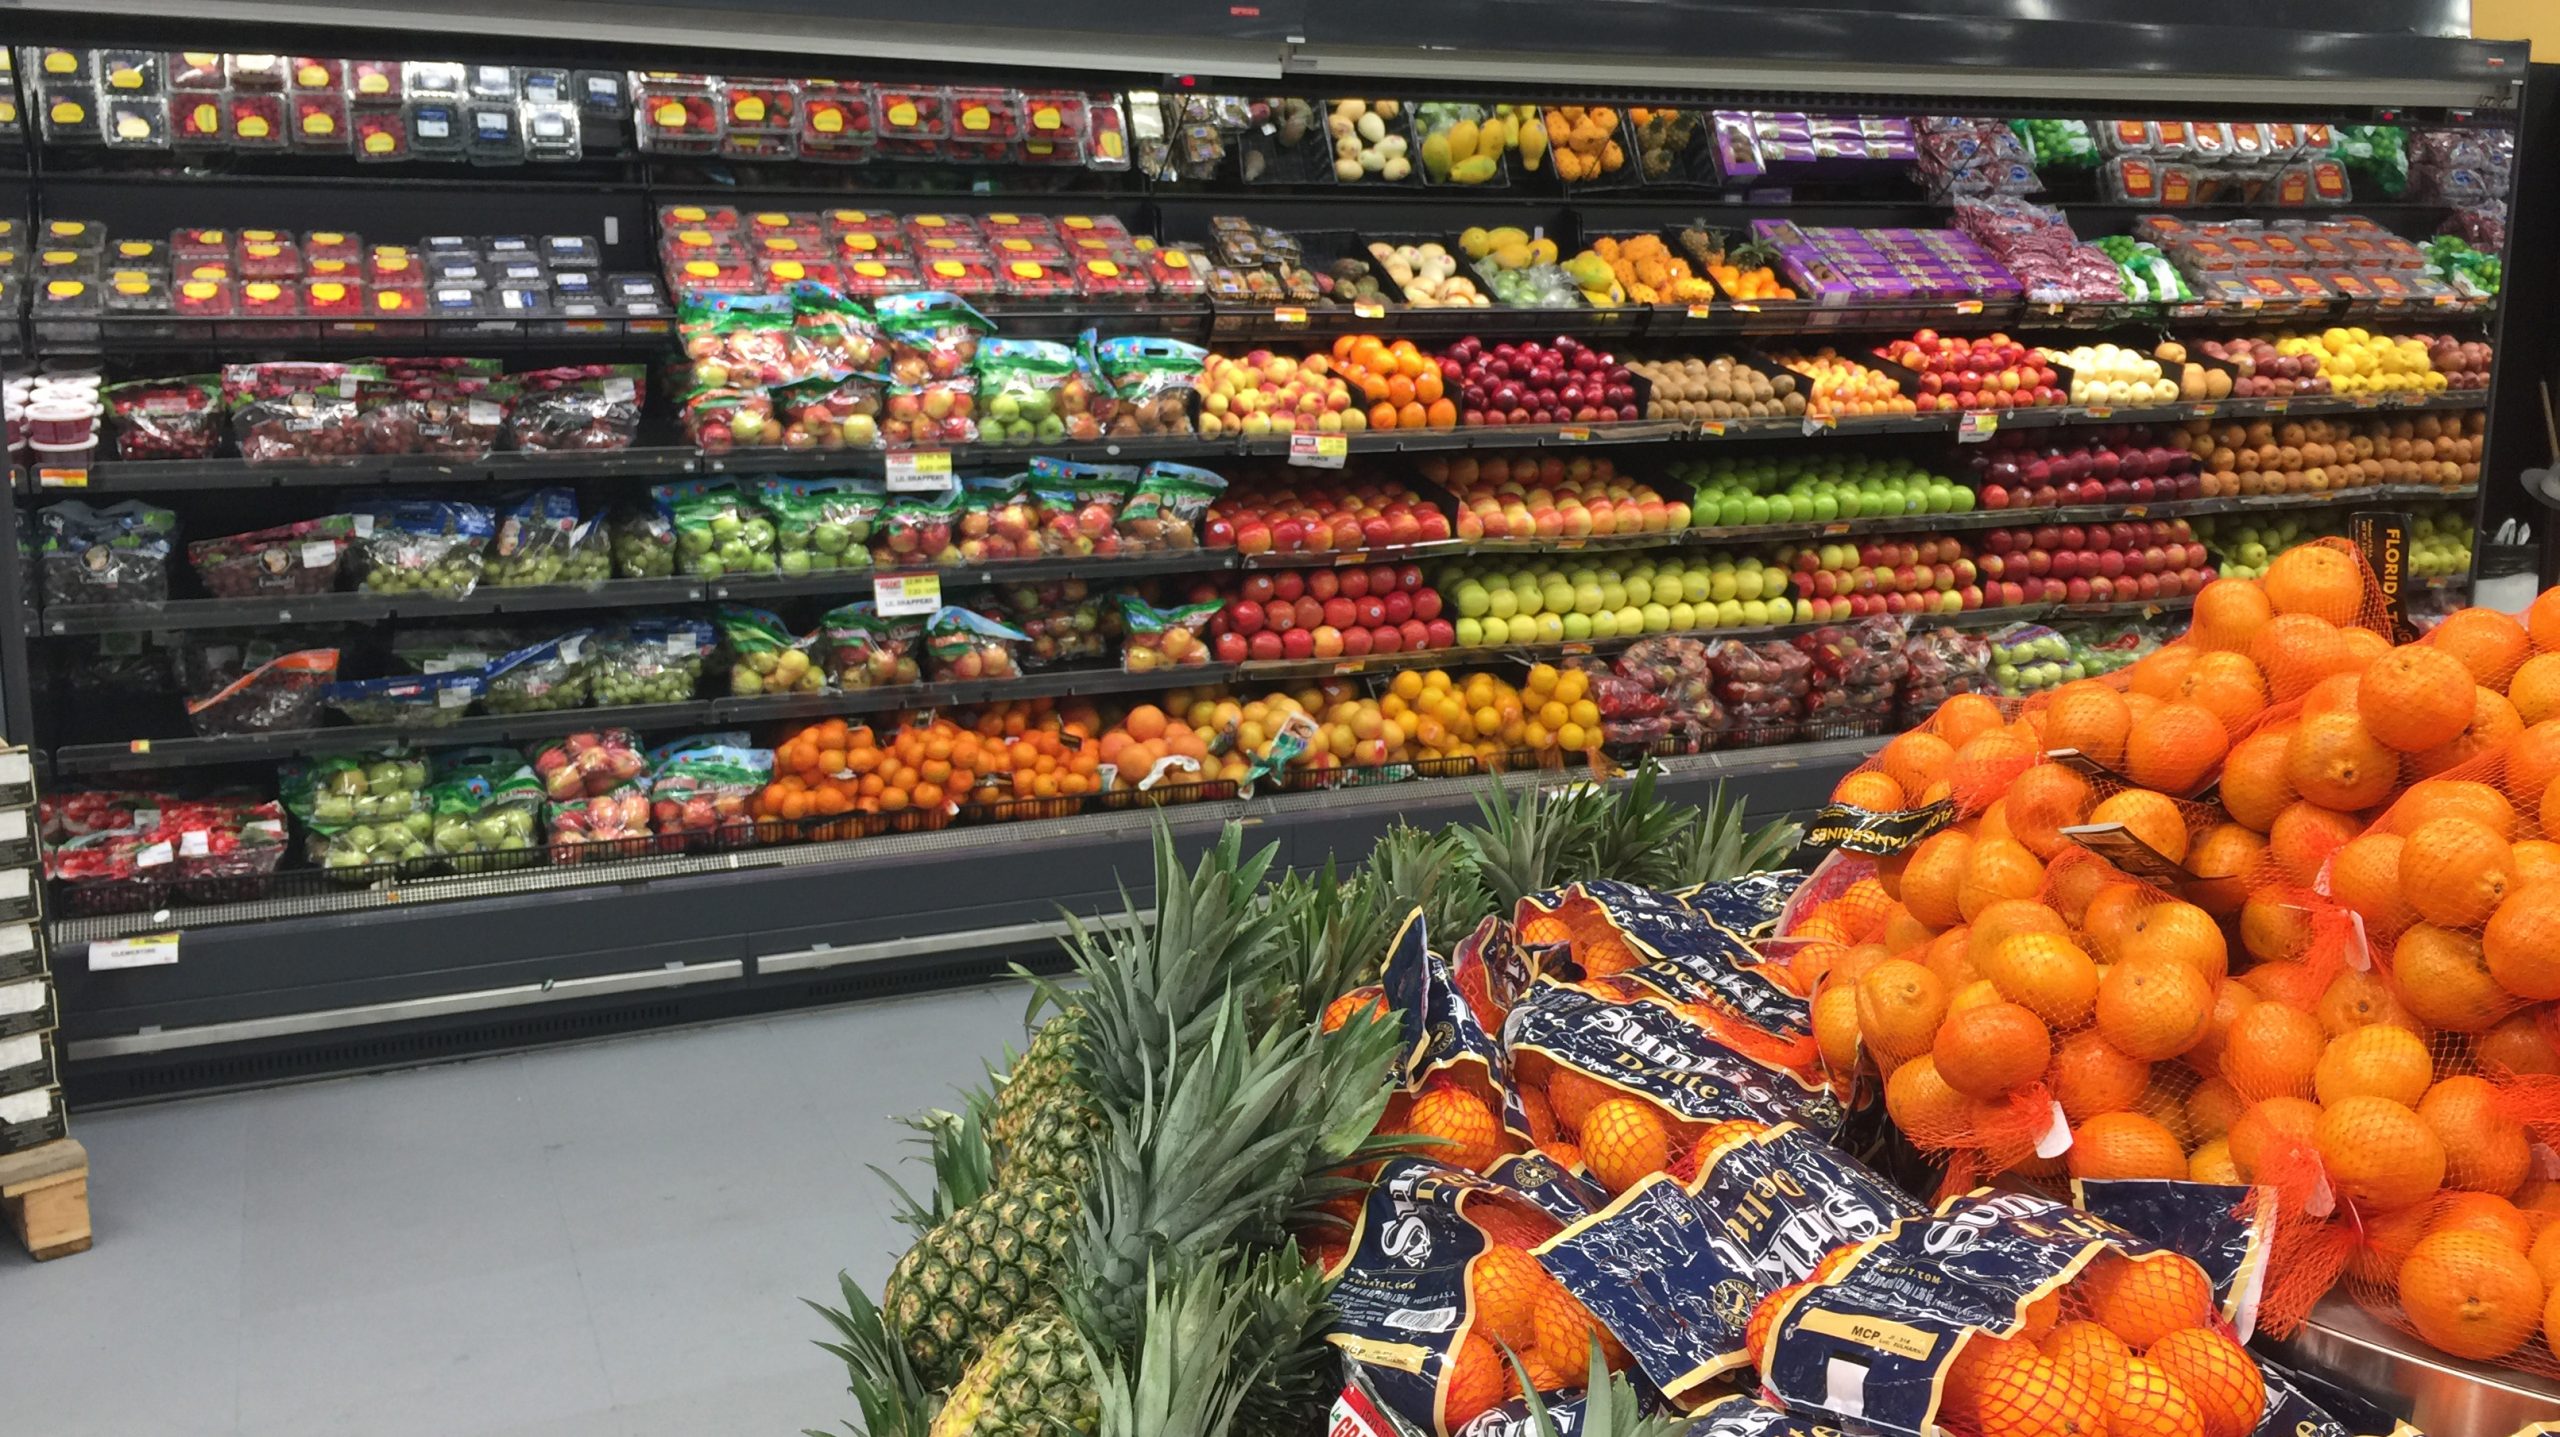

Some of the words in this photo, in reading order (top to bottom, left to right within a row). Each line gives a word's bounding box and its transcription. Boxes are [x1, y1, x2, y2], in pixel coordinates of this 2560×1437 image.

[2383, 528, 2400, 606] FLORIDA
[1811, 827, 1908, 850] TANGERINES
[1851, 1325, 1881, 1340] MCP
